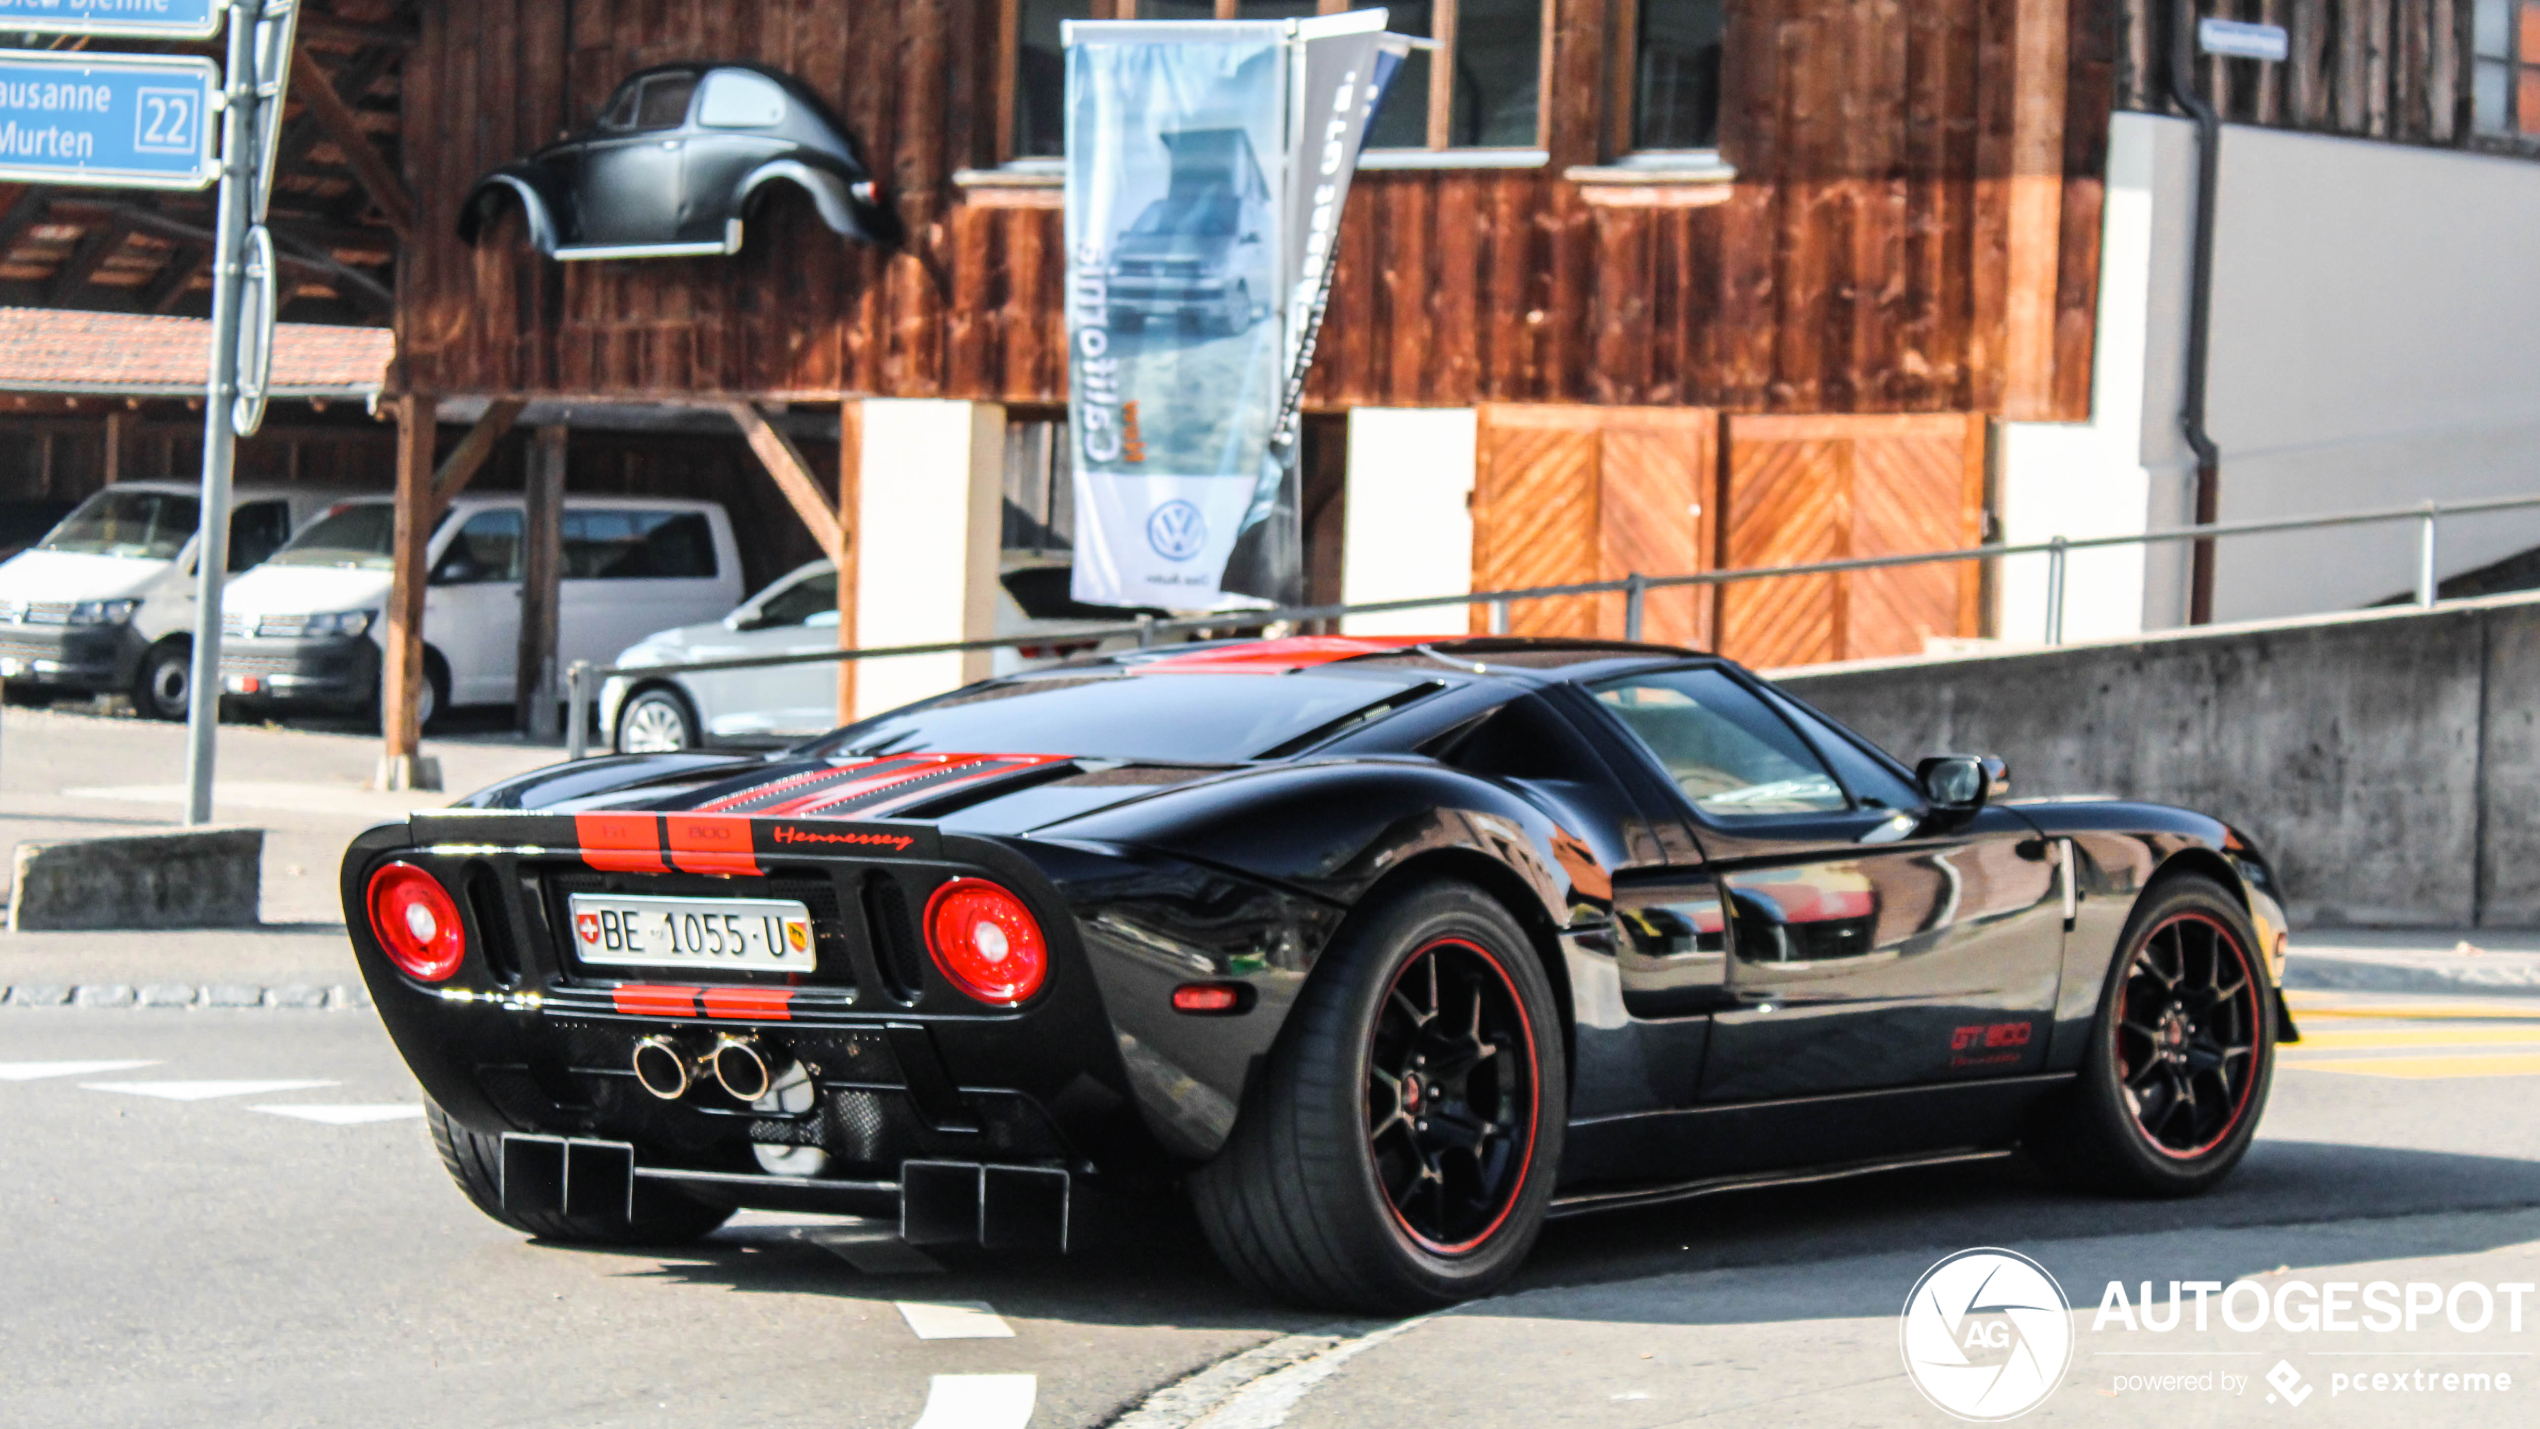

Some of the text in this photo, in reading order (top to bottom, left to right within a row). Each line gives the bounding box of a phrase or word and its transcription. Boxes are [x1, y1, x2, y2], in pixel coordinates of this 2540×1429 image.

[0, 121, 93, 158] Murten
[144, 97, 188, 143] 22
[774, 826, 914, 851] Hennessey
[600, 909, 786, 957] BE 1055 U
